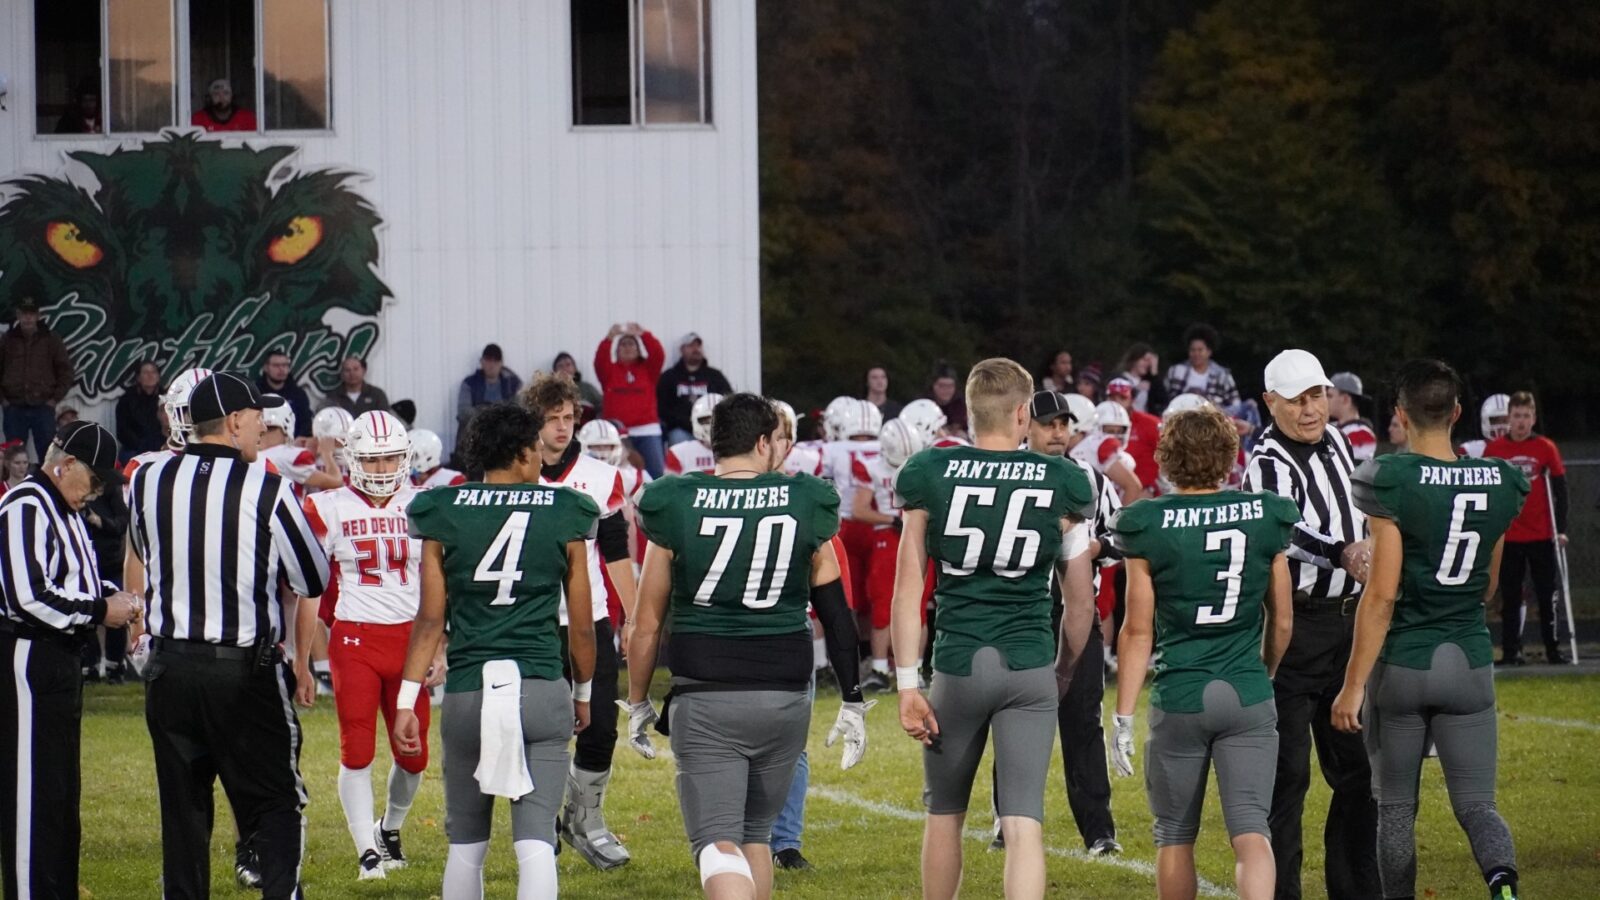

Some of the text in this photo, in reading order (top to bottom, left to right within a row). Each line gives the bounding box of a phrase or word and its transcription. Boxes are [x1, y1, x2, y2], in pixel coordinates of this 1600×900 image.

[943, 459, 1047, 481] PANTHERS
[1419, 465, 1502, 486] PANTHERS
[453, 489, 555, 506] PANTHERS
[692, 485, 790, 509] PANTHERS
[1161, 499, 1264, 528] PANTHERS
[342, 517, 408, 537] RED DEVIL
[940, 485, 1054, 578] 56
[1436, 493, 1488, 586] 6
[351, 536, 410, 587] 24
[473, 511, 531, 605] 4
[692, 514, 798, 609] 70
[1195, 529, 1247, 624] 3
